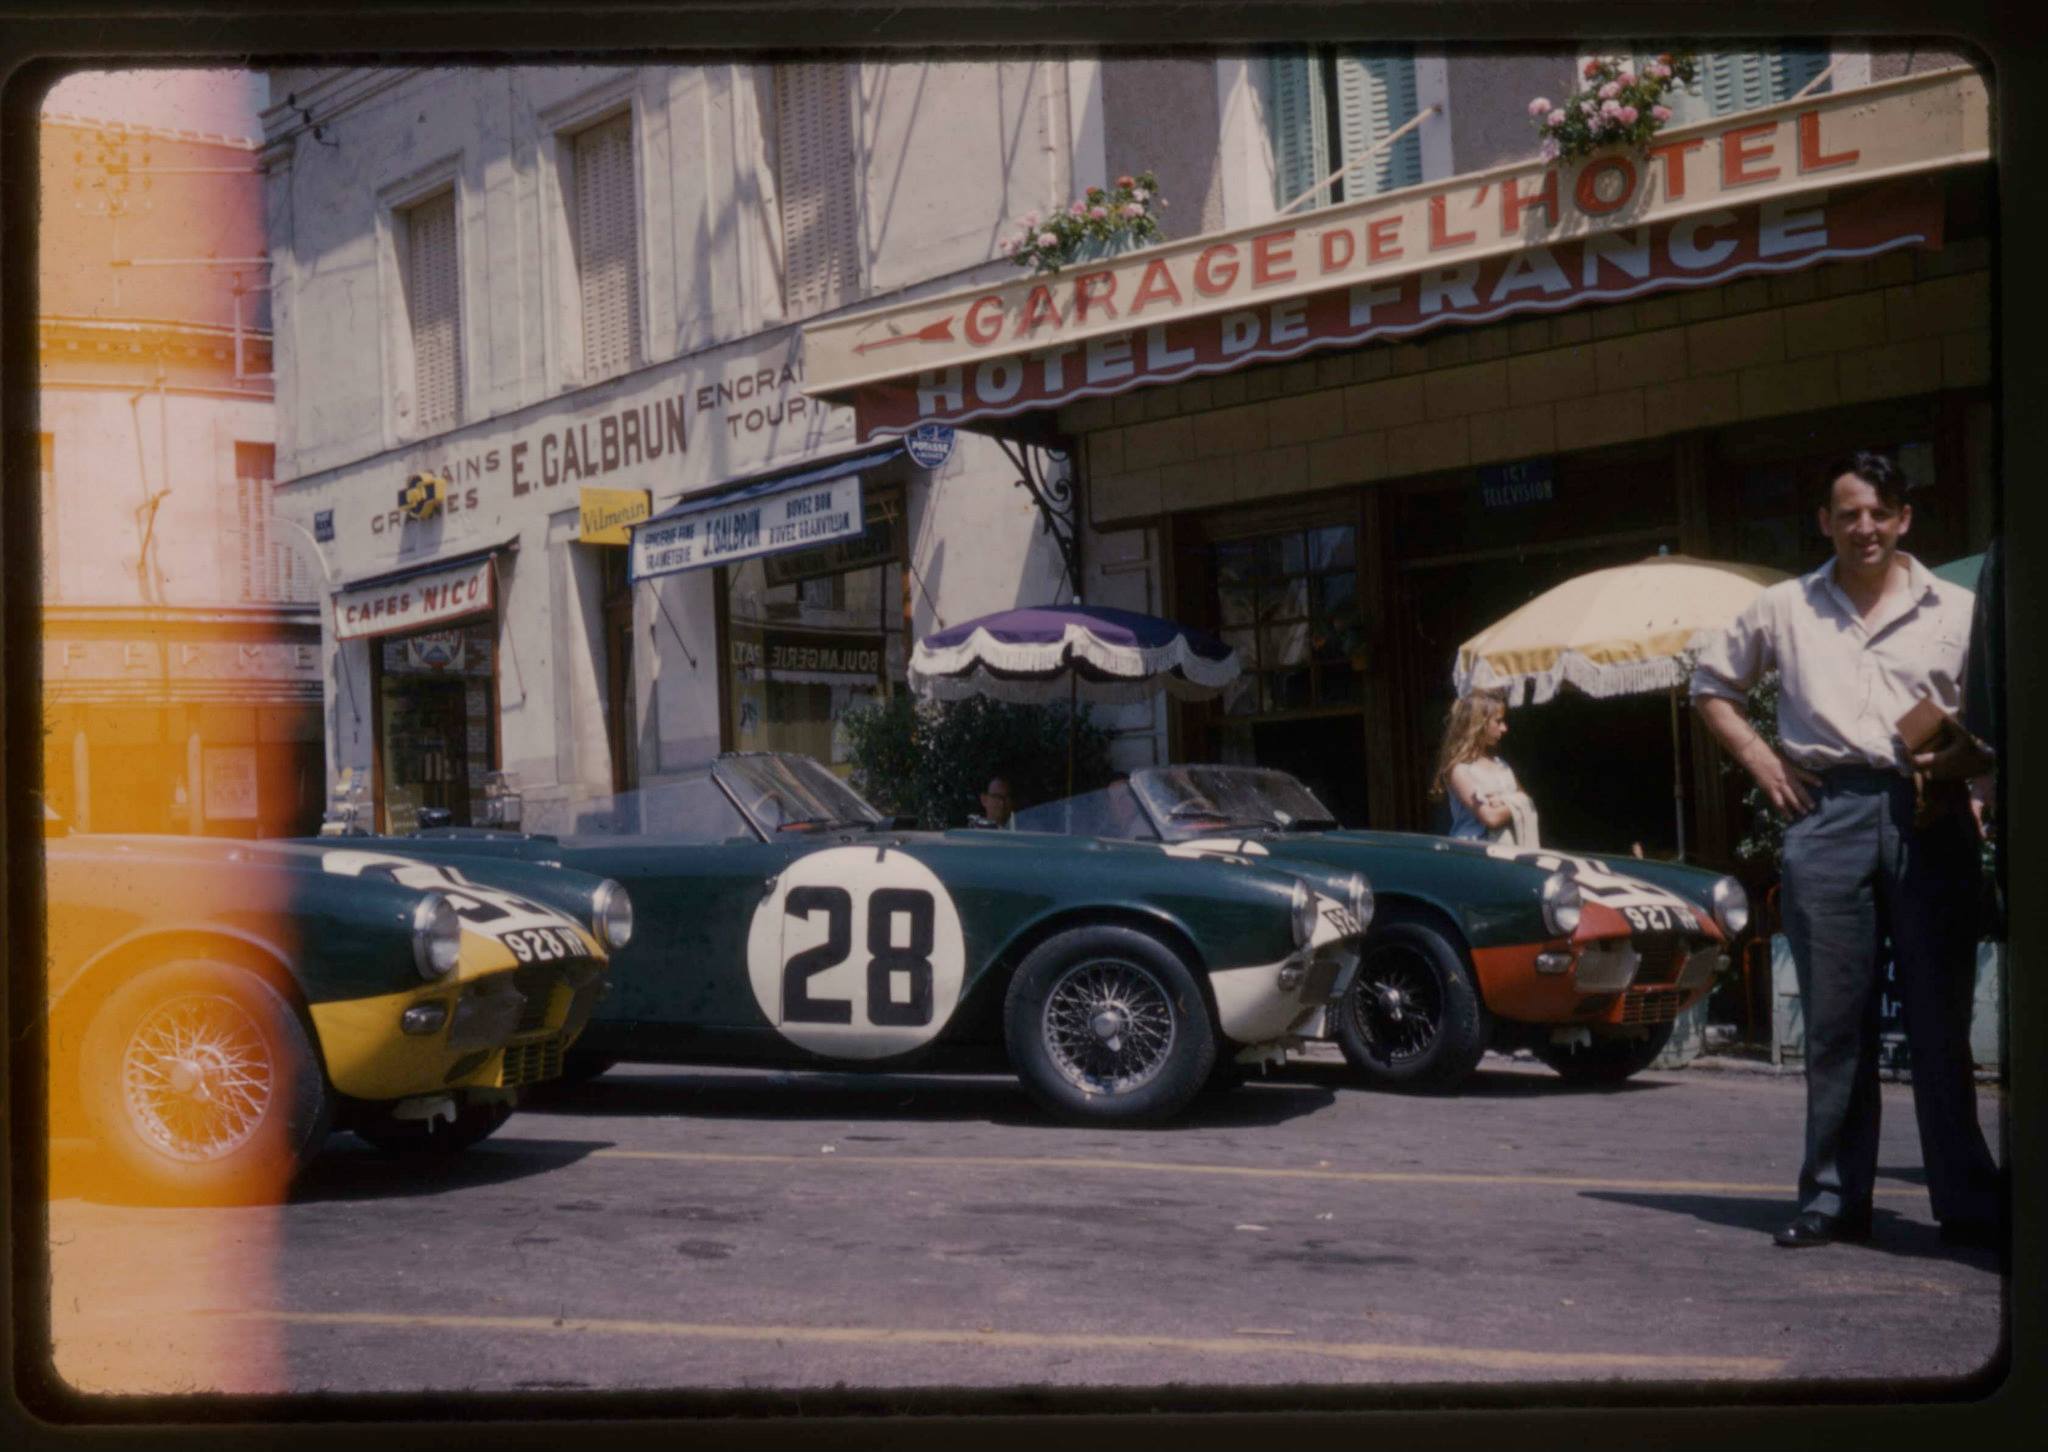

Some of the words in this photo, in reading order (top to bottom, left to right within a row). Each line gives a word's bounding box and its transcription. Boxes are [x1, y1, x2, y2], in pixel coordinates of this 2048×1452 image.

[964, 228, 1299, 346] GARAGE
[1321, 215, 1404, 274] DE
[1429, 110, 1861, 250] L'HOTEL
[917, 327, 1195, 416] HOTEL
[1221, 301, 1308, 355] DE
[1349, 188, 1829, 328] FRANCE
[696, 358, 805, 413] ENGRAI
[428, 449, 501, 486] AINS
[371, 487, 479, 535] GRES
[1624, 905, 1672, 931] 927
[504, 928, 565, 963] 928
[783, 885, 935, 1027] 28
